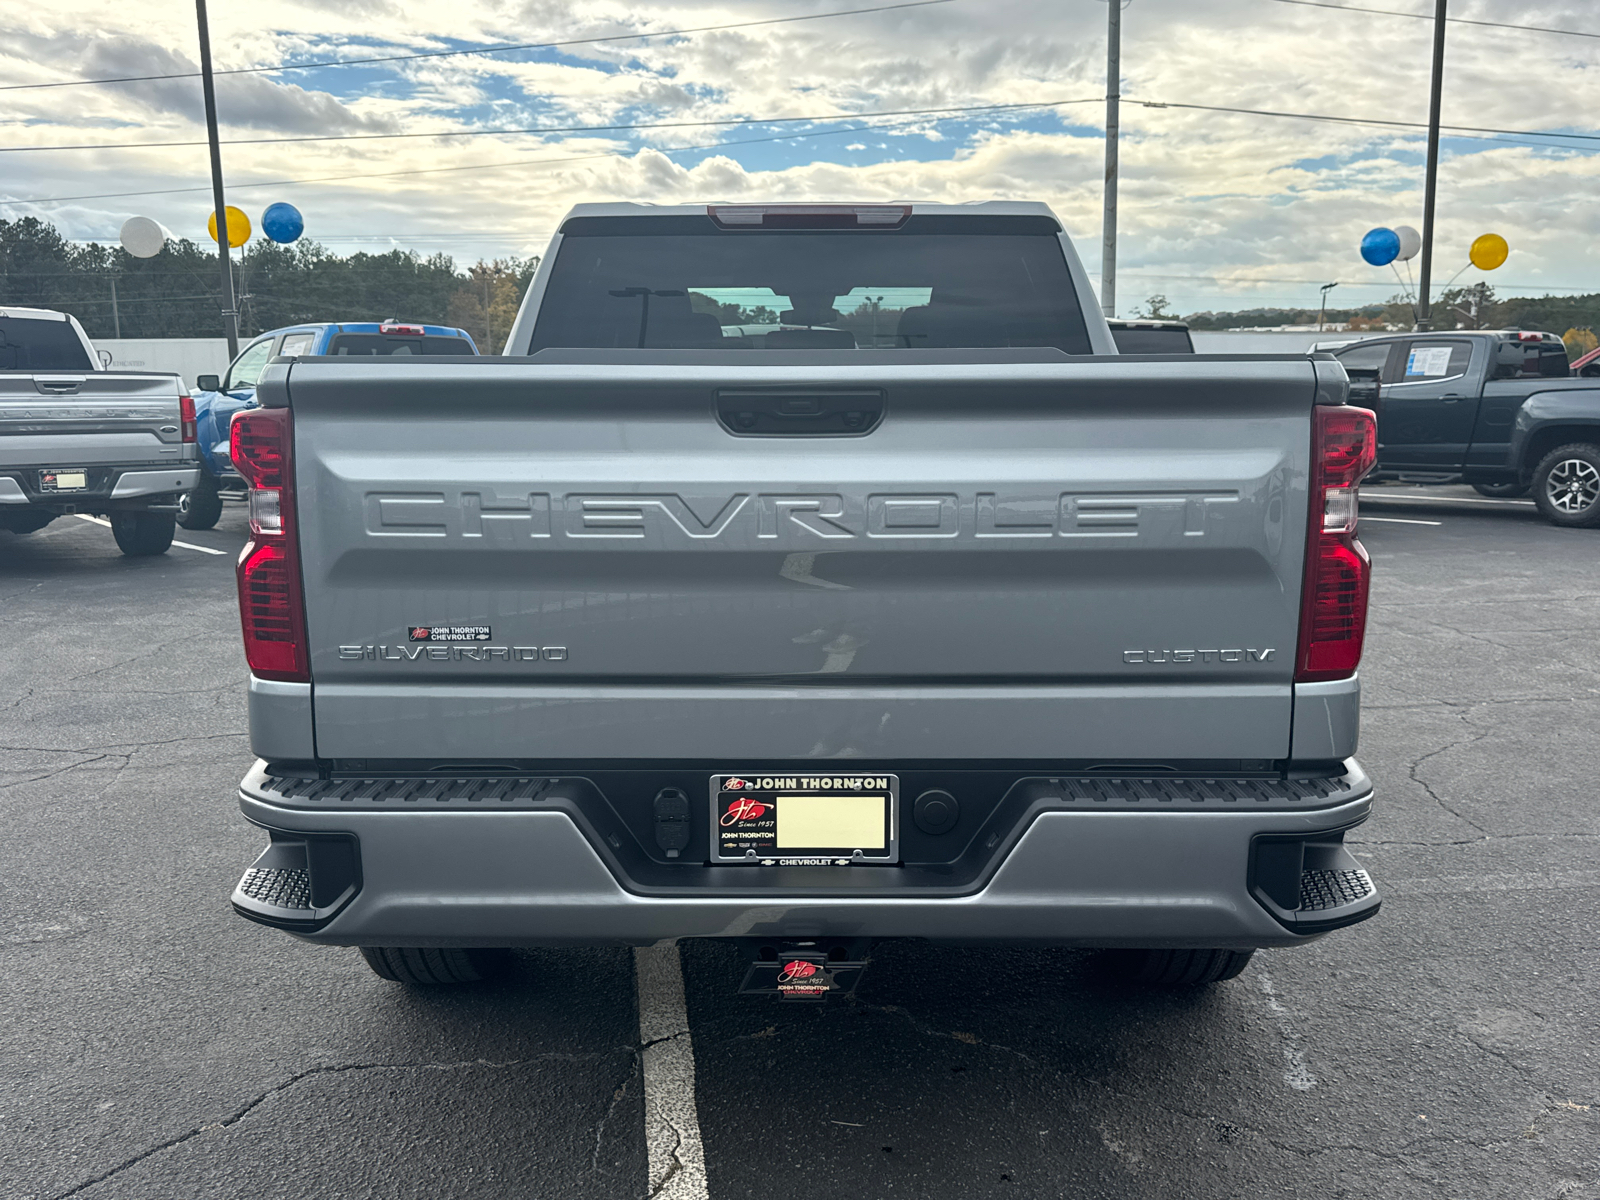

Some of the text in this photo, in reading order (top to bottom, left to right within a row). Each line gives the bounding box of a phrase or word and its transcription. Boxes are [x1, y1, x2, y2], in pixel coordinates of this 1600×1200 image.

[364, 489, 1239, 538] CHEVROLET
[338, 645, 568, 661] SILVERADO
[1123, 648, 1276, 663] CUSTOM
[754, 778, 887, 789] JOHN THORNTON
[738, 820, 775, 828] Since 1957
